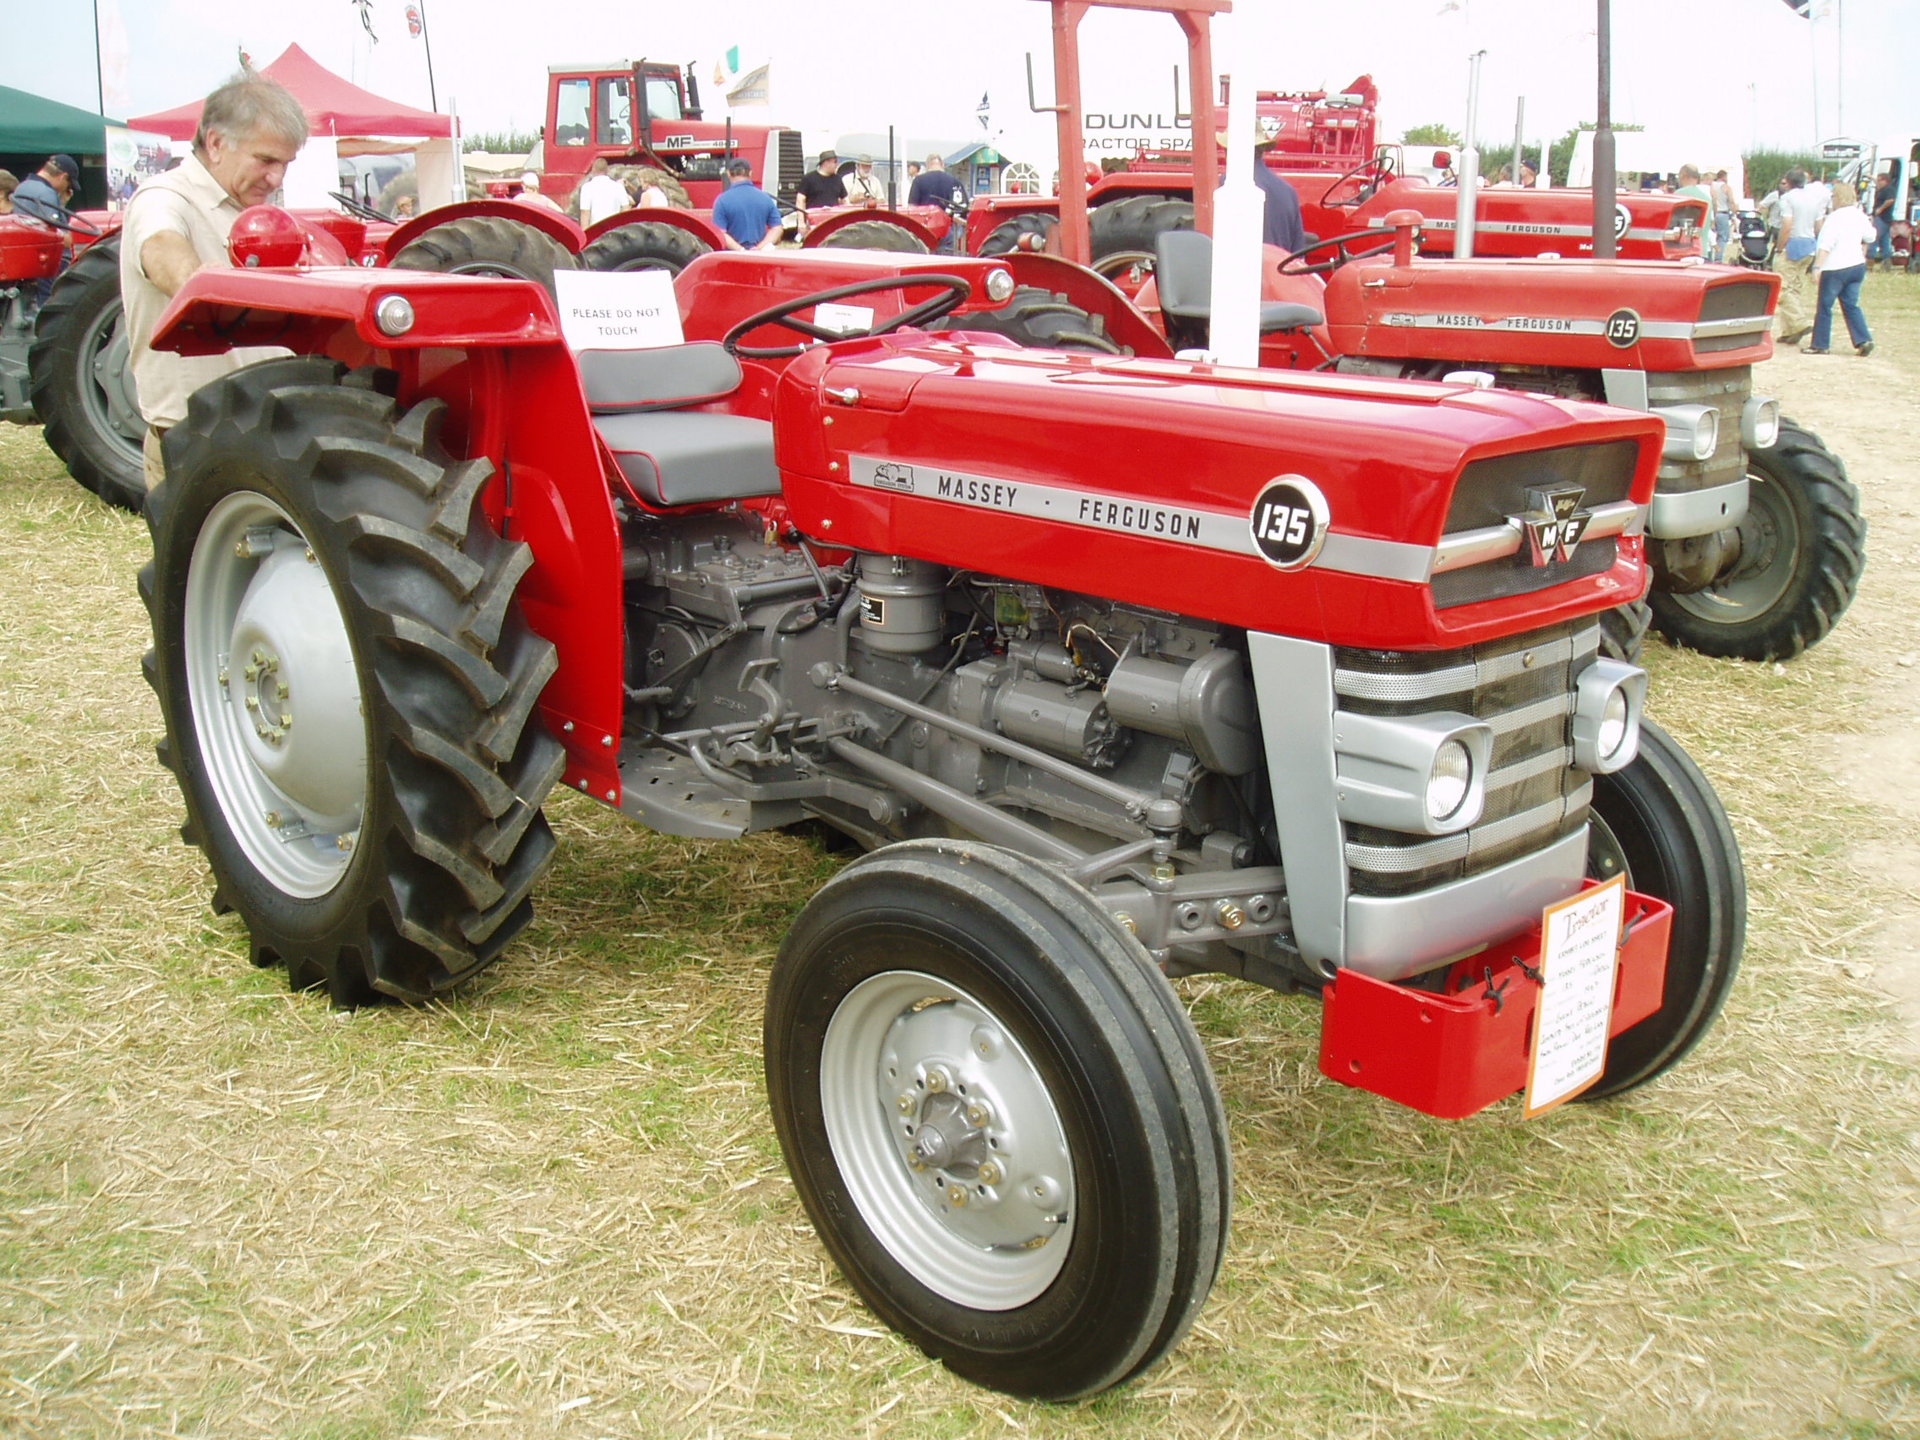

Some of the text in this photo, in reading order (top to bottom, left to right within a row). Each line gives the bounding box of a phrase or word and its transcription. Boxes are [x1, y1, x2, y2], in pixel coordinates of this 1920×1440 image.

[1085, 113, 1192, 129] DUNLO
[667, 137, 692, 149] MF
[1082, 138, 1193, 150] ACTOR SPA
[1505, 224, 1562, 234] FERGUSON
[573, 307, 661, 319] PLEASE DO NOT
[1436, 314, 1573, 332] MASSEY FERGUSON
[1607, 318, 1637, 340] 135
[597, 326, 639, 336] TOUCH
[938, 474, 1202, 540] MASSEY FERGUSON
[1257, 502, 1311, 545] 135
